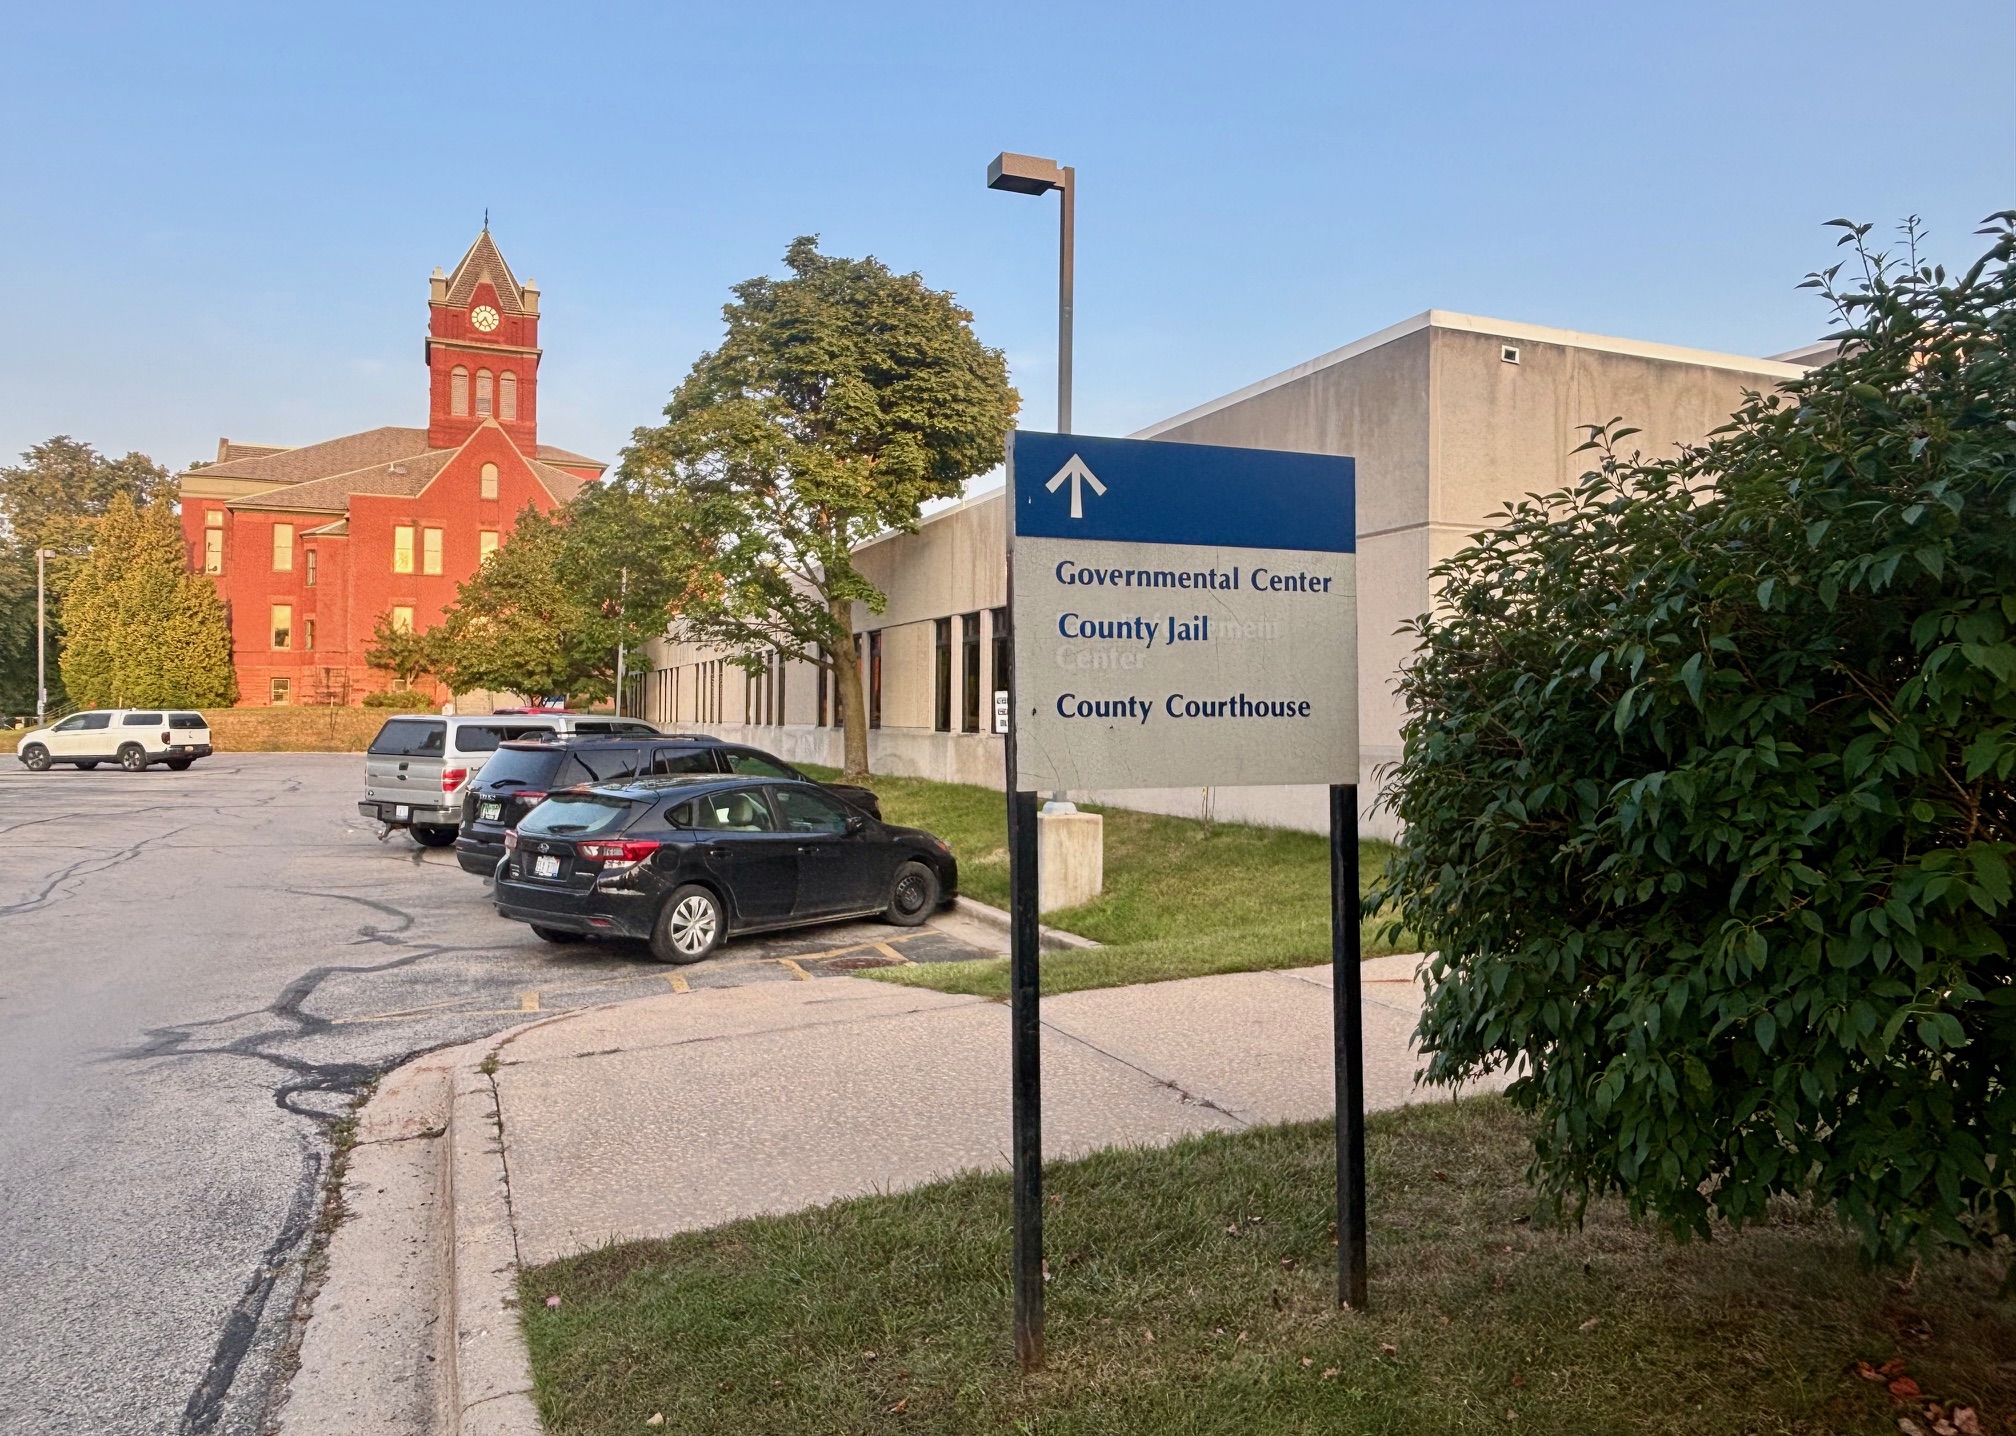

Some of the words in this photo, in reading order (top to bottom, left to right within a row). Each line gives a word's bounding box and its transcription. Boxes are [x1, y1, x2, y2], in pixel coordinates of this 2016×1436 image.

[1055, 560, 1239, 590] Governmental
[1250, 568, 1332, 593] Center
[1058, 612, 1158, 649] County
[1165, 614, 1208, 645] Jail
[1056, 693, 1153, 725] County
[1165, 693, 1311, 718] Courthouse
